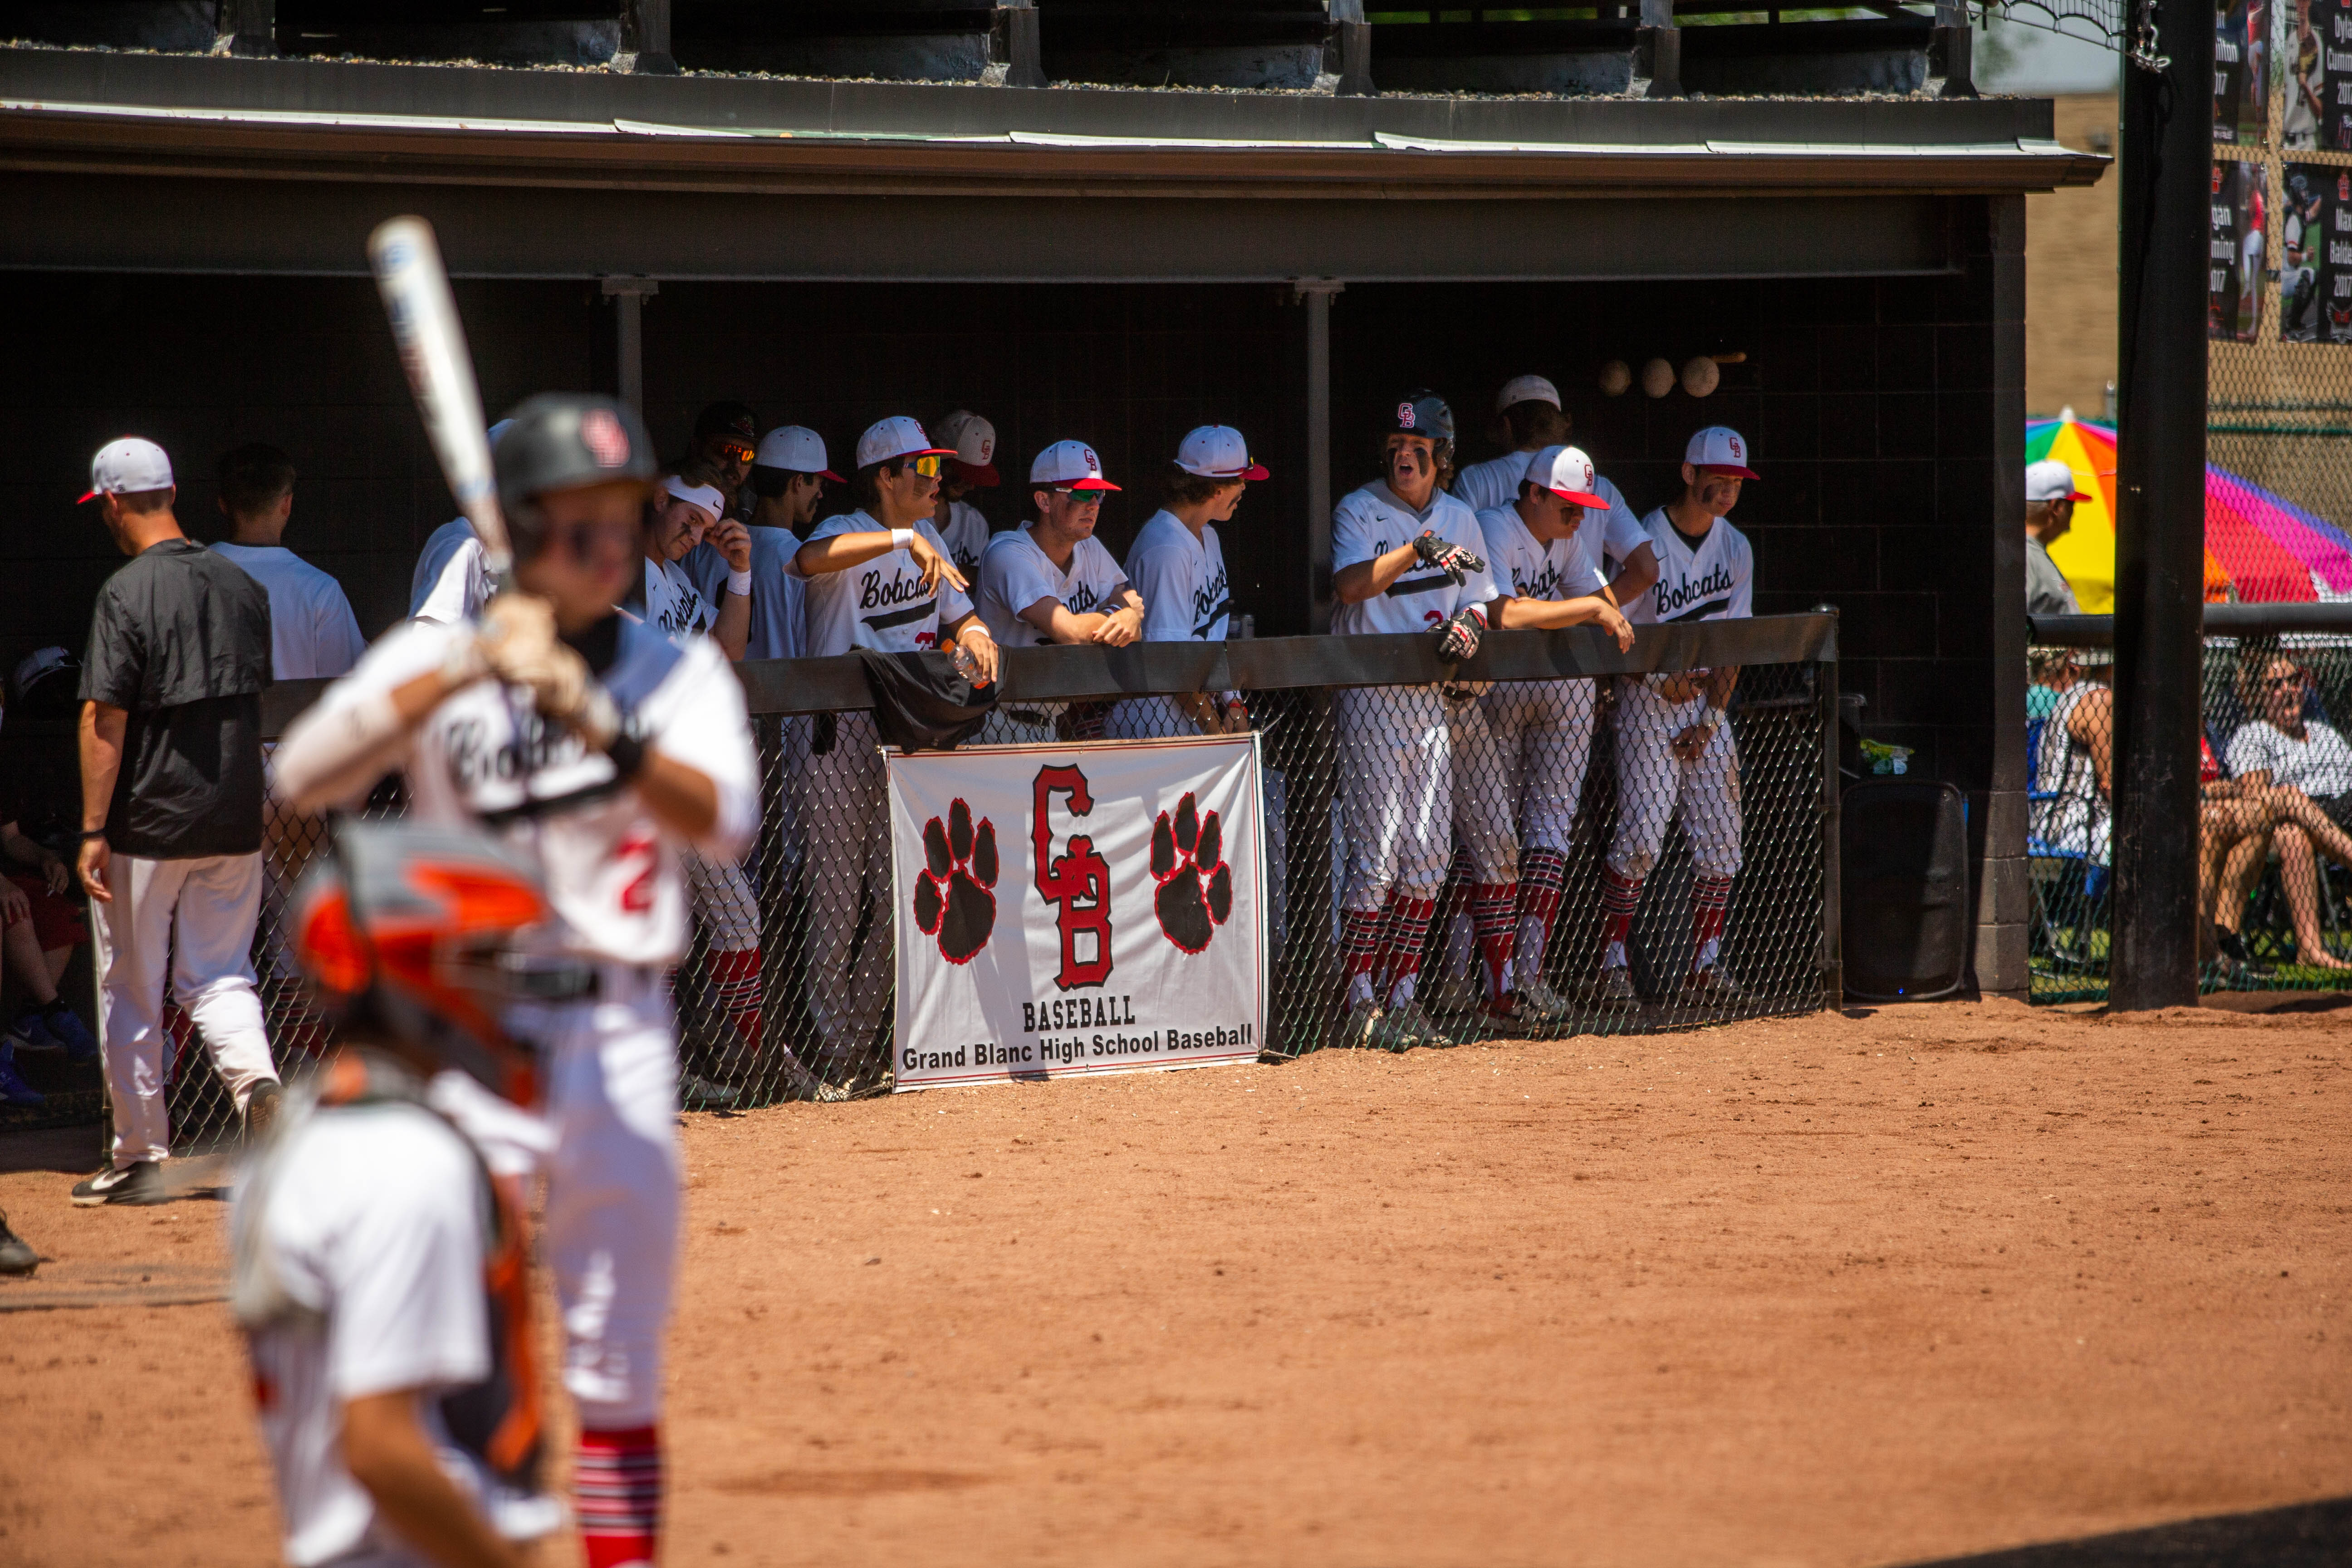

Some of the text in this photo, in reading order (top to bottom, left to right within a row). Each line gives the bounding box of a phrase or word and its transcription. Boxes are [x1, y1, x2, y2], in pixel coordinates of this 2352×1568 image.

[2334, 275, 2352, 297] 2017
[1398, 403, 1416, 428] GB
[1084, 449, 1097, 471] GB
[1729, 437, 1741, 458] GB
[1652, 564, 1735, 616] Bobcats
[1023, 995, 1135, 1033] BASEBALL
[902, 1023, 1252, 1070] Grand Blanc High School Baseball
